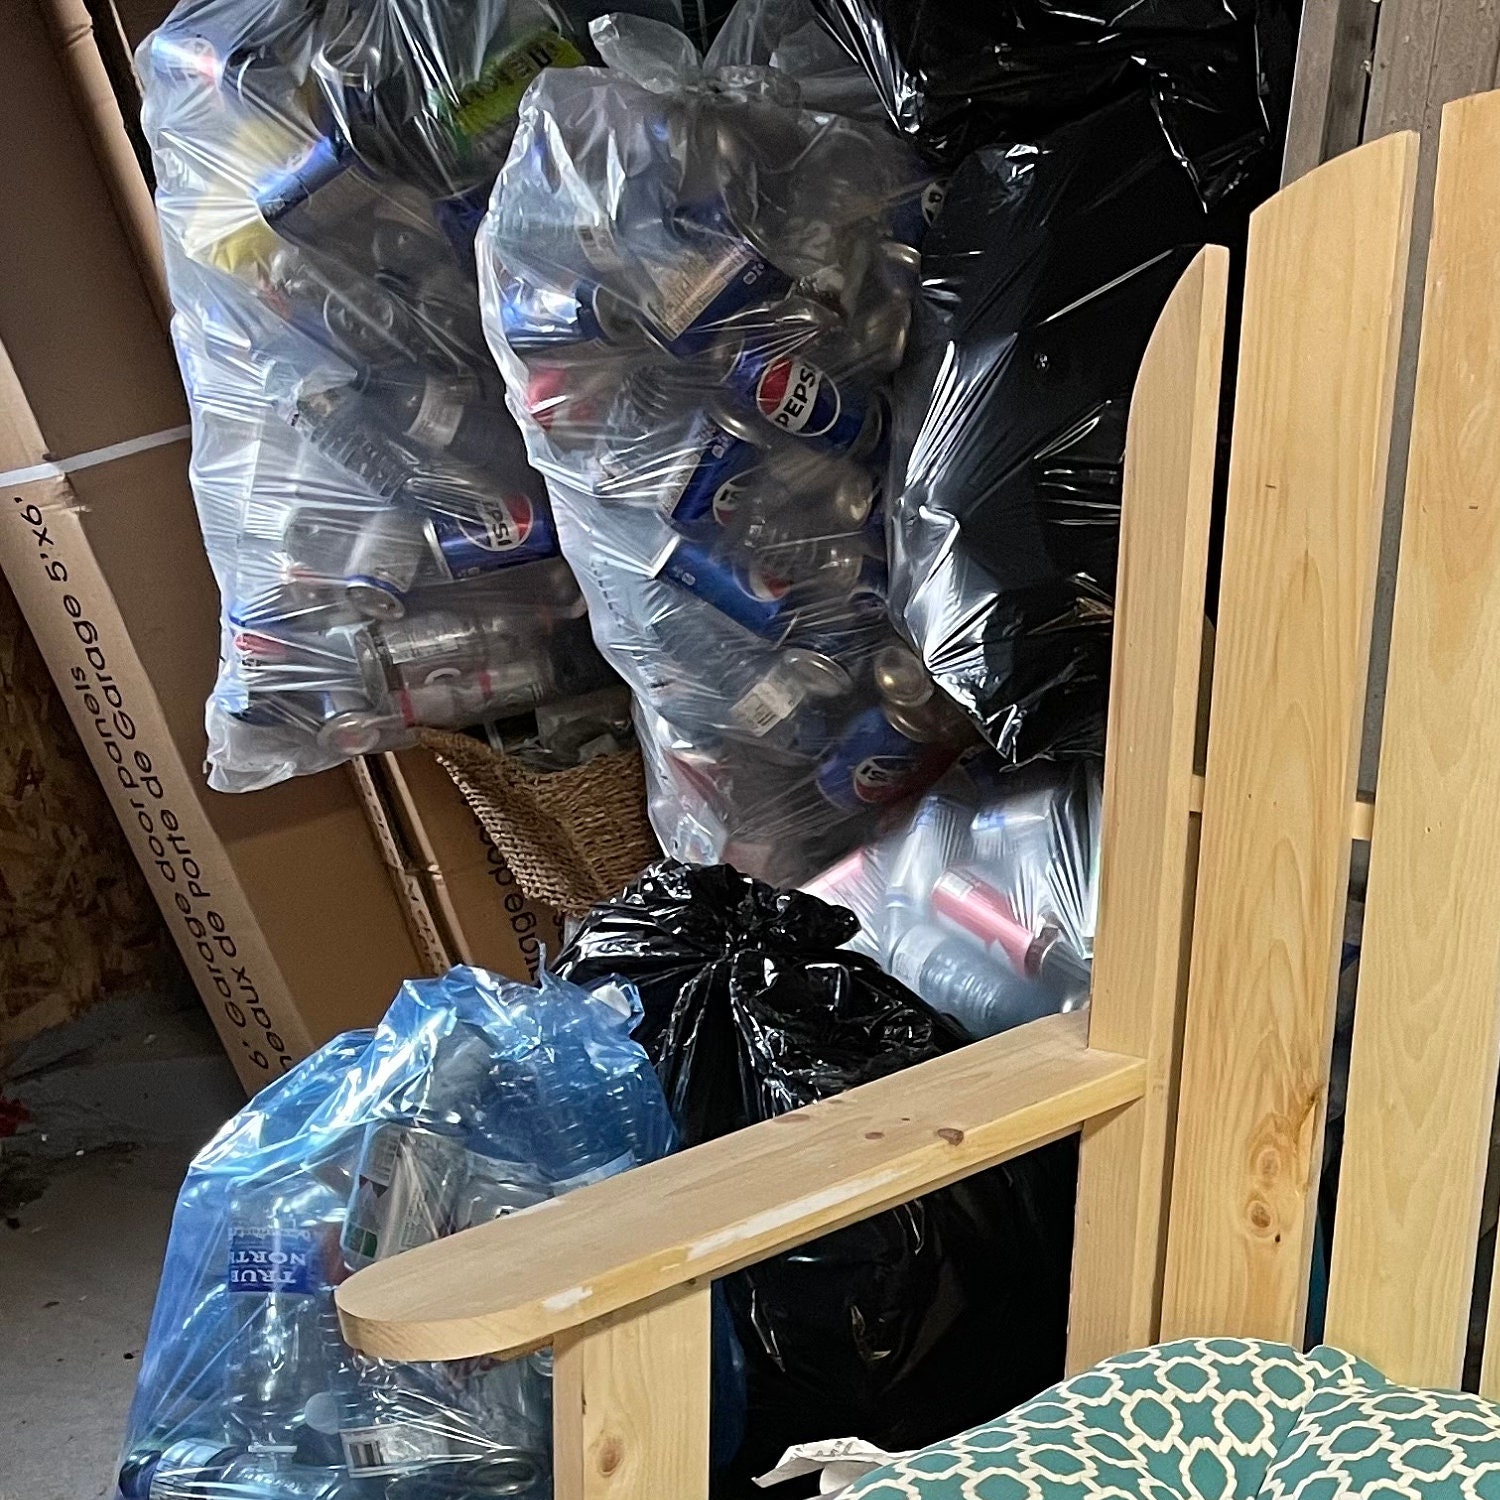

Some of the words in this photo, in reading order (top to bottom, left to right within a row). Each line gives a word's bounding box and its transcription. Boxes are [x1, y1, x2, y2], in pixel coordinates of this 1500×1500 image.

[63, 594, 136, 740] Garage
[71, 666, 140, 789] panels
[134, 750, 164, 799] de
[130, 799, 176, 883] door
[160, 810, 211, 897] Porte
[175, 892, 246, 1028] Garage
[207, 911, 237, 958] de
